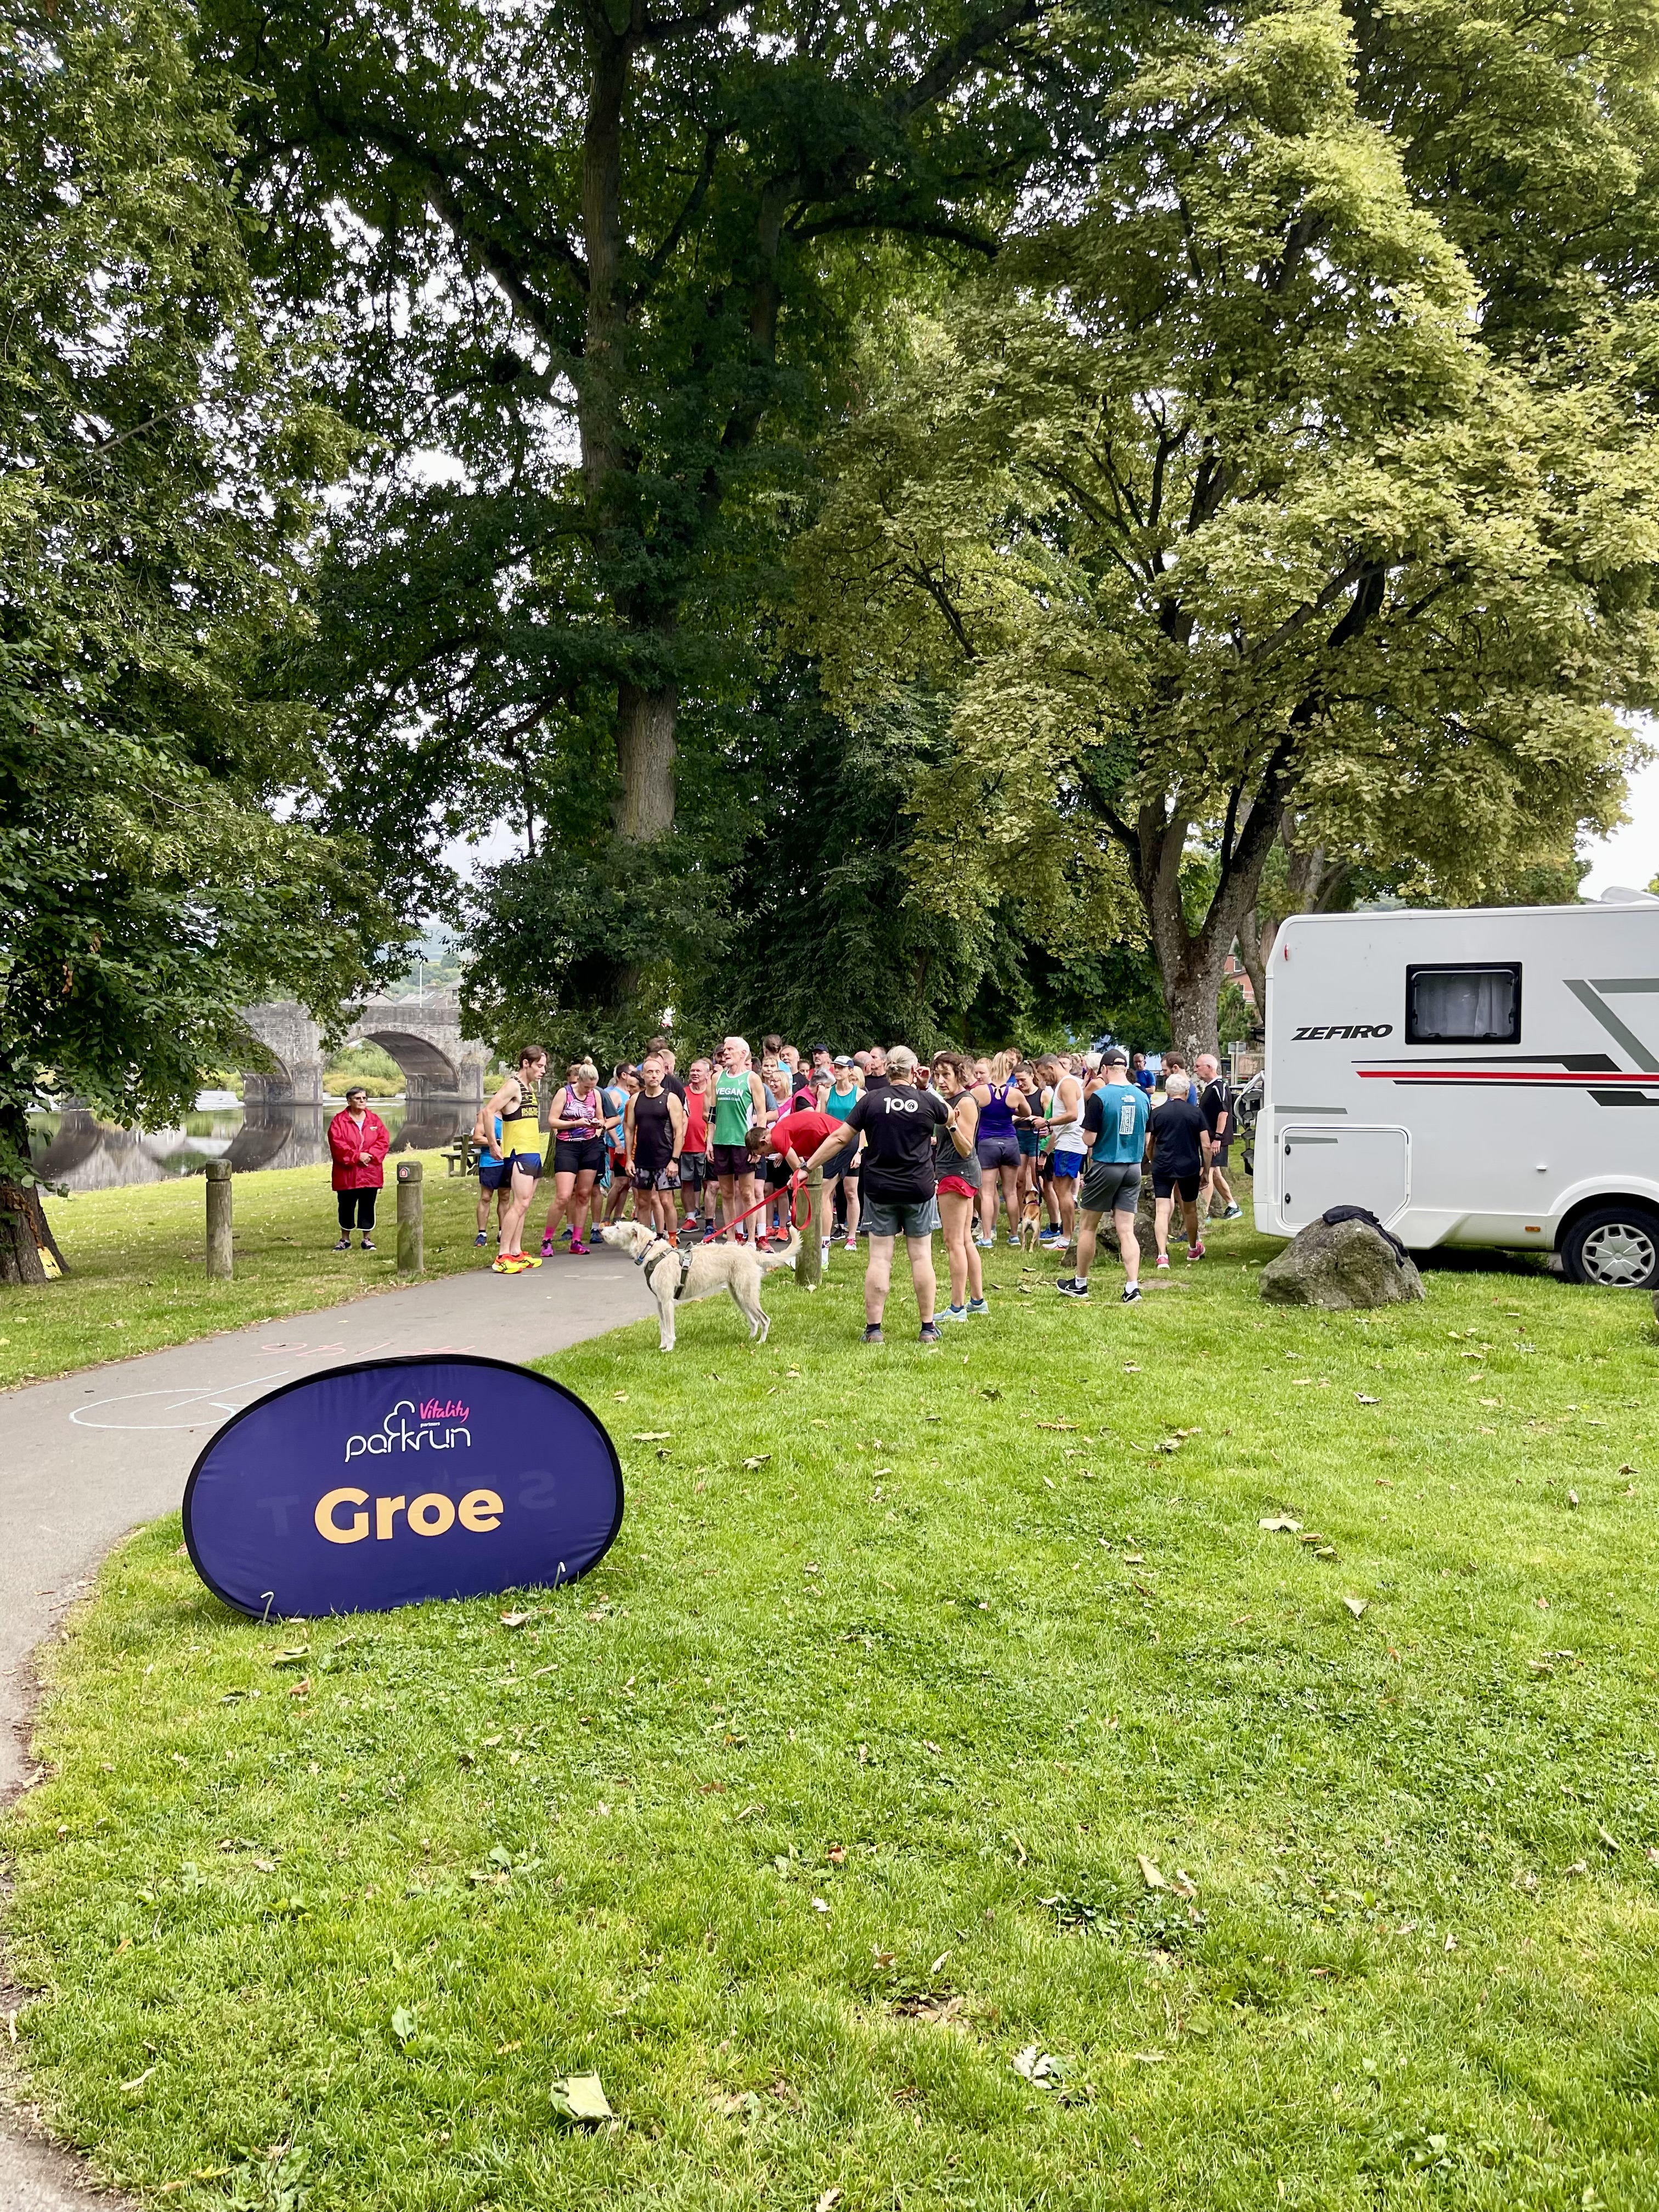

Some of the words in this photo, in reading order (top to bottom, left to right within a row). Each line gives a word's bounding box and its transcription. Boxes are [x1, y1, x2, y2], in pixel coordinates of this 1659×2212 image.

[1290, 1024, 1393, 1041] ZEFIRO
[715, 1087, 743, 1097] VEGAN
[883, 1097, 918, 1114] 100
[419, 1398, 470, 1424] Vitality
[345, 1414, 471, 1463] parkrun
[314, 1487, 504, 1544] Groe
